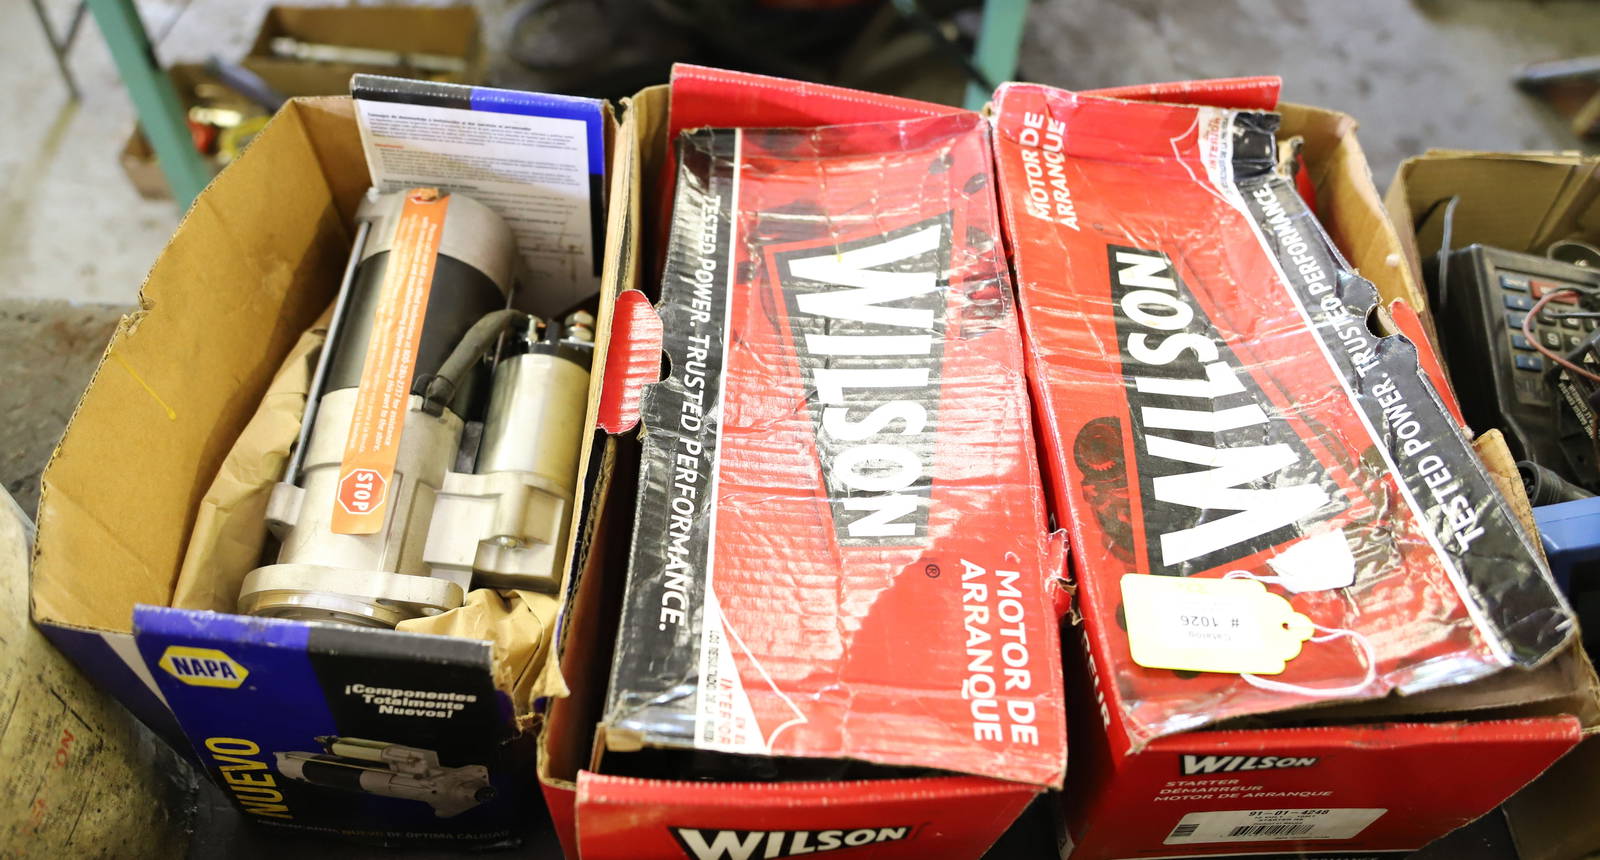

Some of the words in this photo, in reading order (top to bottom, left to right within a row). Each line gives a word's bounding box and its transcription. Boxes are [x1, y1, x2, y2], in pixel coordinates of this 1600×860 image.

[1019, 111, 1044, 147] DE
[1021, 149, 1054, 222] MOTOR
[1043, 118, 1080, 231] ARRANQUE
[701, 195, 721, 255] TESTED
[690, 256, 717, 327] POWER.
[1320, 293, 1380, 378] TRUSTED
[680, 334, 711, 432] TRUSTED
[788, 224, 942, 537] WILSON
[1116, 251, 1332, 567] WILSON
[1372, 372, 1432, 457] POWER.
[352, 472, 374, 511] STOP
[1418, 455, 1485, 551] TESTED
[658, 437, 702, 631] PERFORMANCE.
[960, 558, 1003, 742] ARRANQUE
[995, 570, 1031, 691] MOTOR
[1180, 615, 1218, 627] 1026
[173, 657, 237, 680] NAPA
[345, 683, 477, 703] ¡Componentes
[362, 694, 465, 710] Totalmente
[378, 704, 453, 718] Nuevos!
[1007, 701, 1039, 746] DE
[205, 737, 293, 820] NUEVO
[1154, 793, 1213, 801] MOTOR
[1244, 790, 1334, 798] ARRANQUE
[1166, 779, 1240, 787] STARTER
[1183, 755, 1317, 775] WILSON
[678, 827, 908, 860] WILSON
